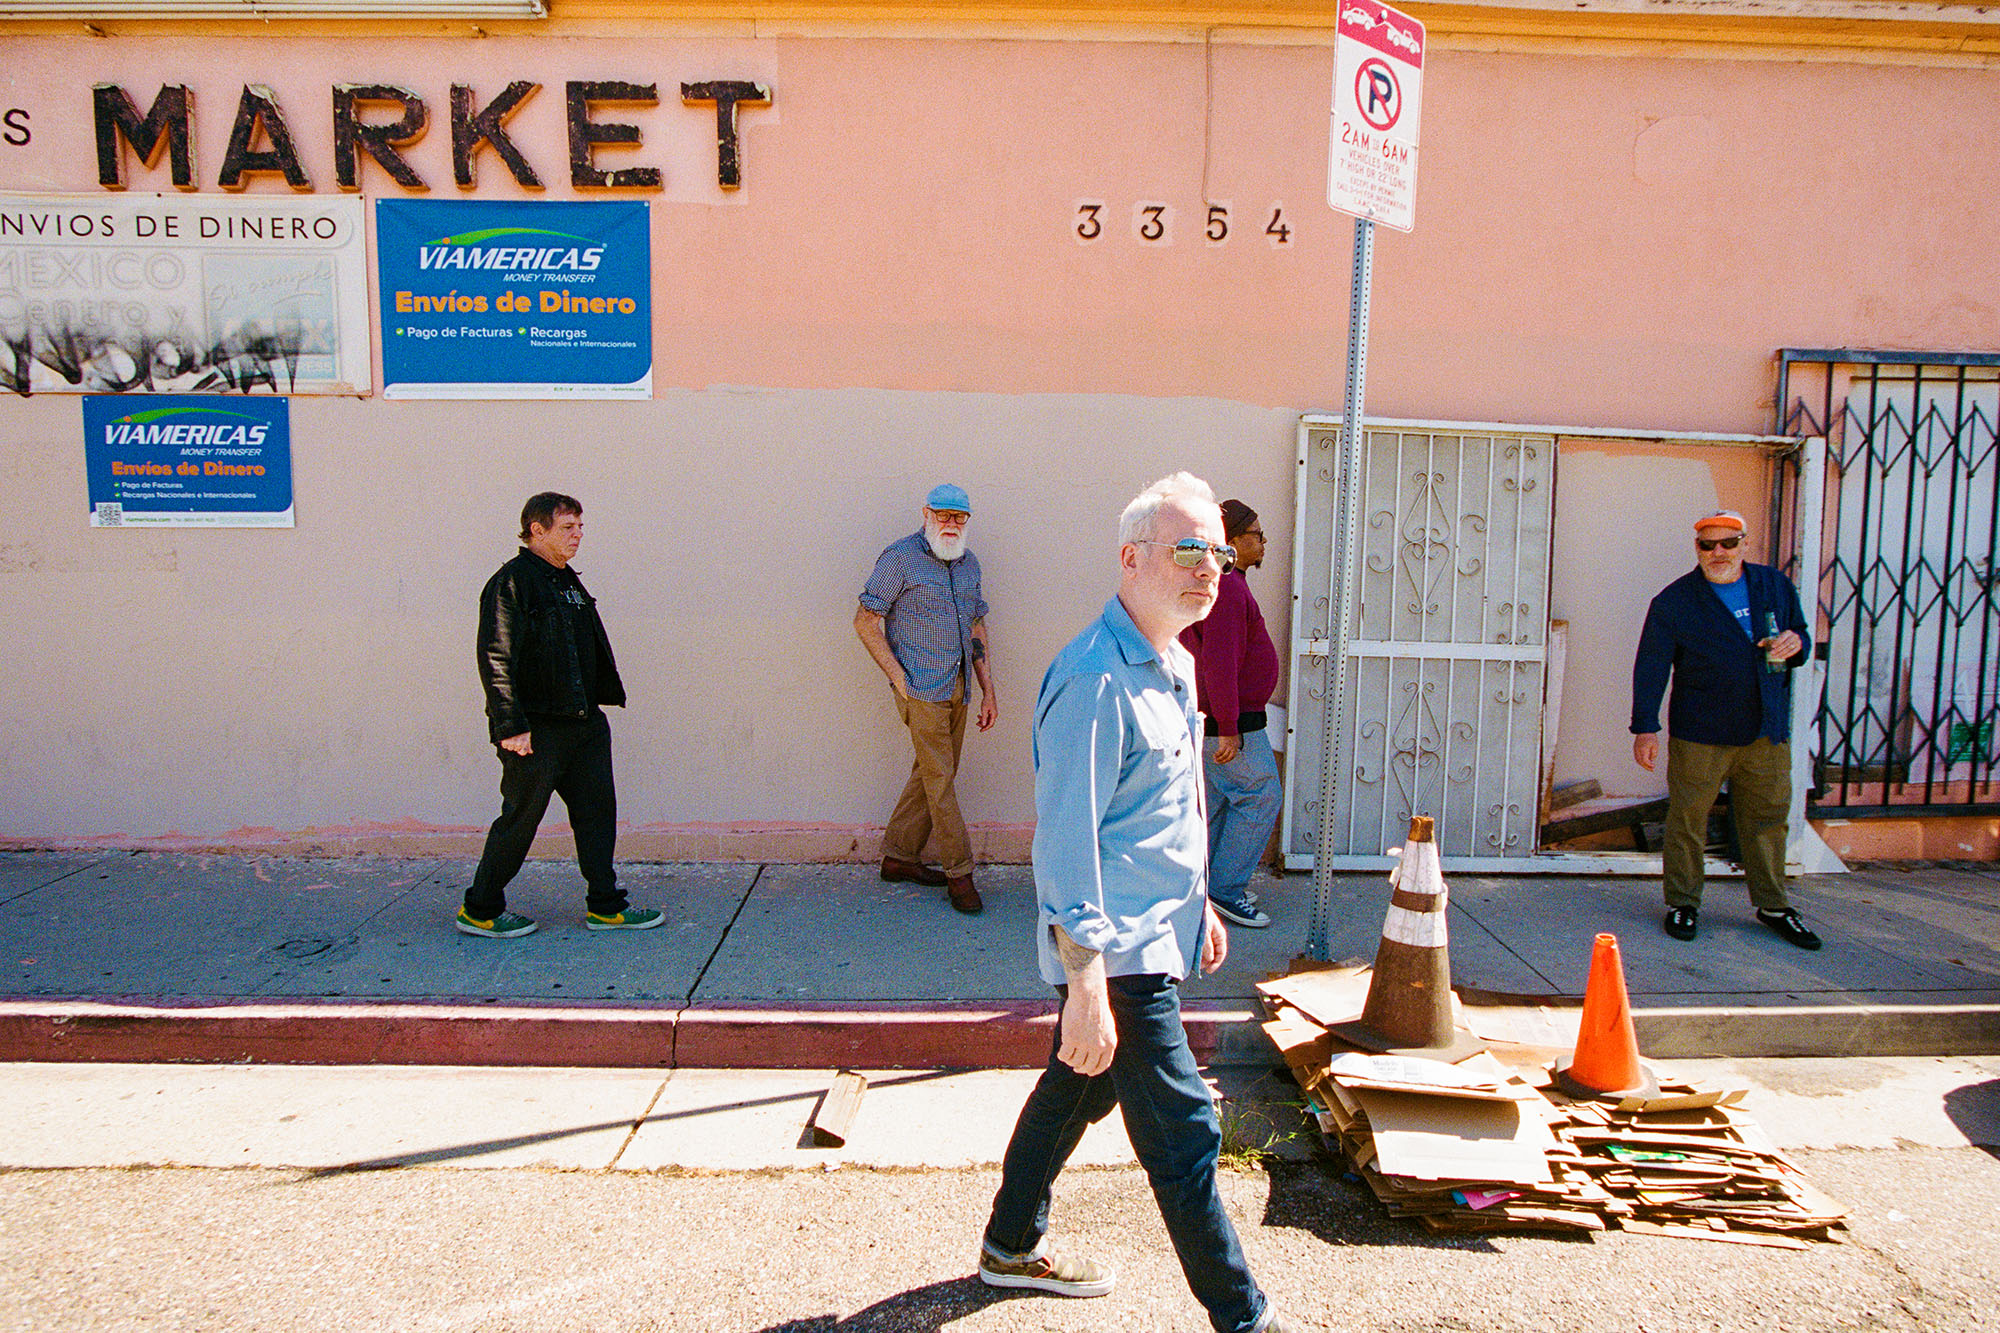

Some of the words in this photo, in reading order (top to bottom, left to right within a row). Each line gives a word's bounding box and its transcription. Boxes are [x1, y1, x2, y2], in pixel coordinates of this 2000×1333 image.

[3, 108, 31, 146] S
[92, 81, 772, 192] MARKET
[1341, 121, 1370, 151] 2AM
[1382, 138, 1408, 166] 6AM
[1349, 148, 1381, 169] VEHICLES
[1383, 160, 1400, 176] OVER
[136, 215, 180, 238] DE
[200, 216, 337, 239] DINERO
[1077, 204, 1291, 243] 3354
[420, 246, 604, 271] VIAMERICAS
[502, 273, 540, 283] MONEY
[542, 273, 596, 284] TRANSFER
[395, 289, 489, 313] Envíos
[495, 290, 532, 313] de
[539, 289, 636, 315] Dinero
[407, 326, 438, 341] Pago
[441, 326, 457, 338] de
[460, 326, 513, 338] Facturas
[530, 326, 588, 341] Recargas
[530, 340, 572, 348] Nacionales
[580, 340, 637, 348] Internacionales
[105, 424, 269, 446] VIAMERICAS
[180, 447, 214, 456] MONEY
[214, 447, 262, 456] TRANSFER
[111, 460, 173, 476] Envíos
[176, 461, 199, 476] de
[203, 460, 266, 476] Dinero
[121, 481, 140, 490] Pago
[141, 481, 151, 489] de
[152, 481, 184, 489] Facturas
[122, 491, 155, 500] Recargas
[156, 491, 196, 499] Nacionales
[203, 491, 257, 499] Internacionales
